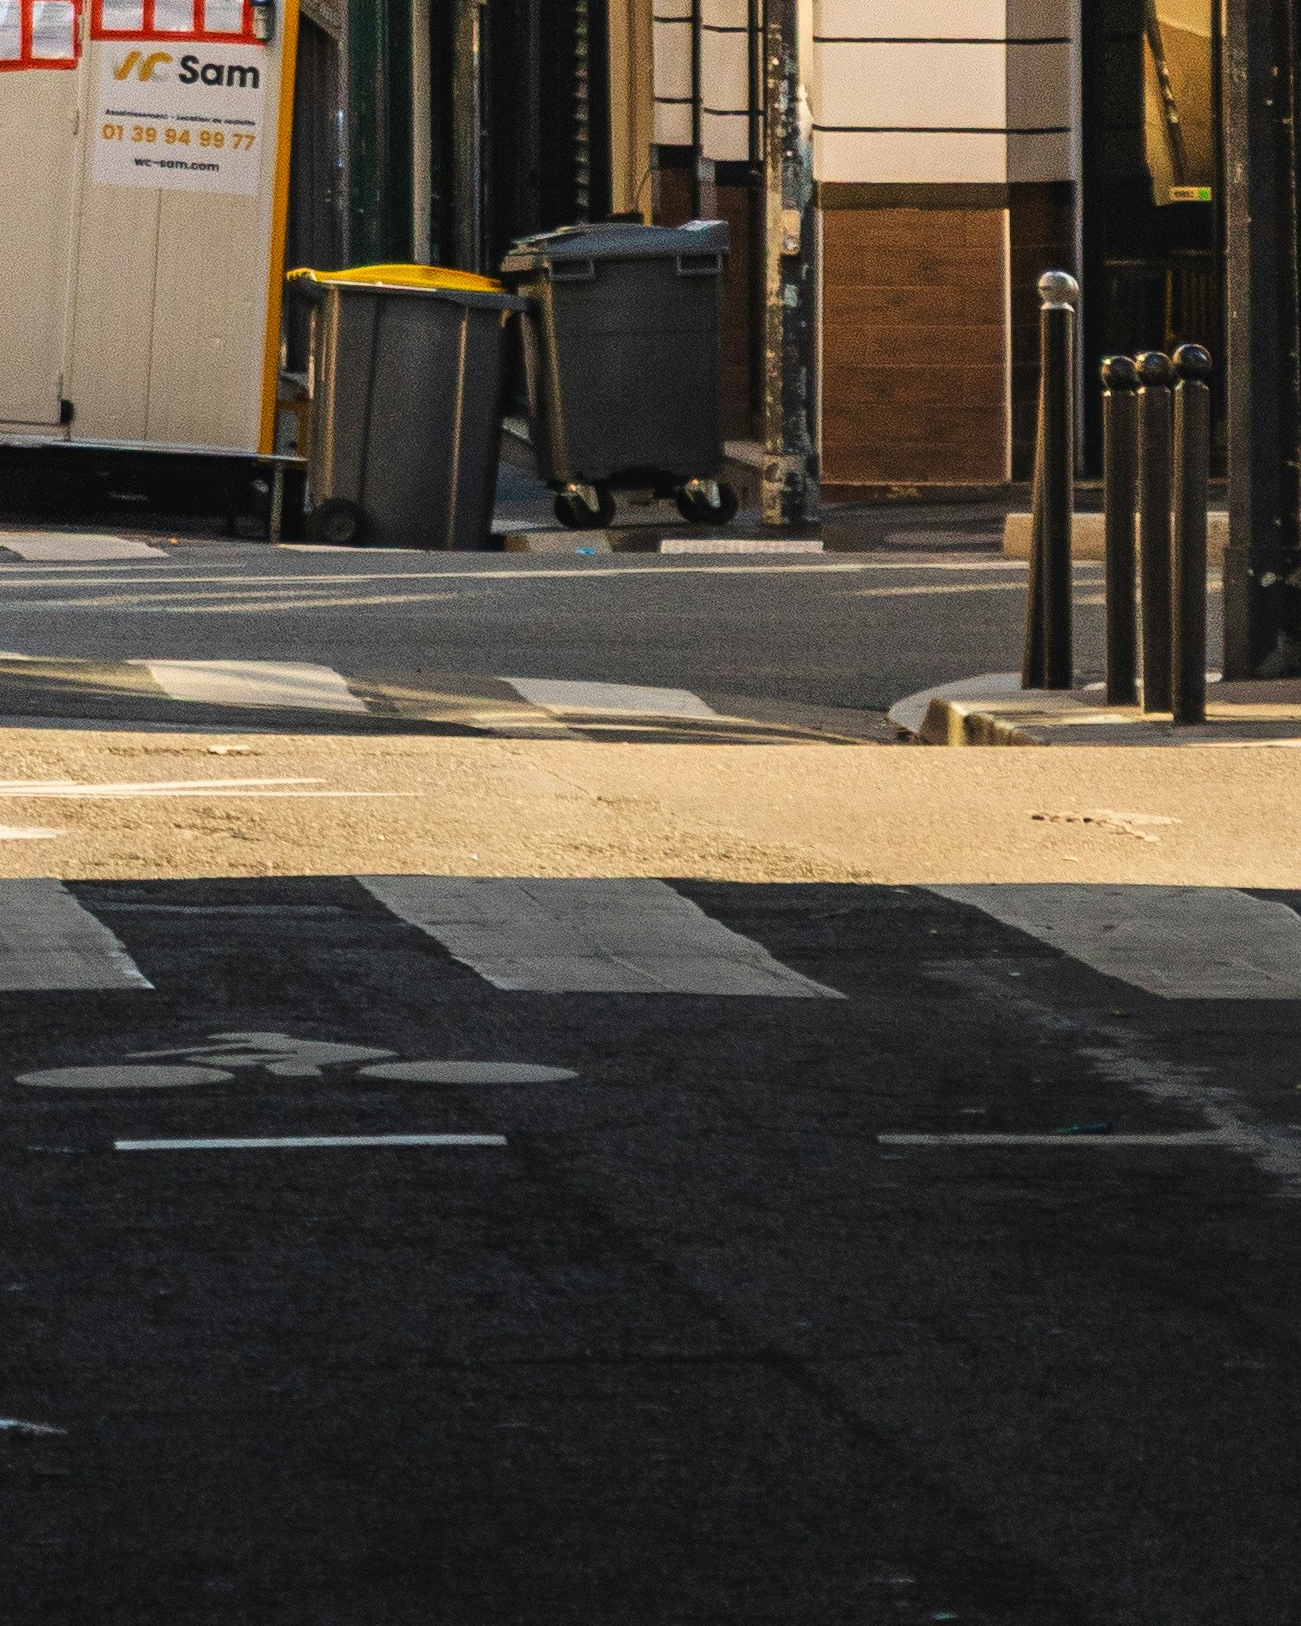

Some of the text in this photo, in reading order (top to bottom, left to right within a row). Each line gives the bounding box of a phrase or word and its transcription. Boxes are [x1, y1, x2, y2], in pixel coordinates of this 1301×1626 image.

[178, 54, 260, 89] Sam
[102, 123, 124, 141] 01
[231, 133, 256, 151] 77
